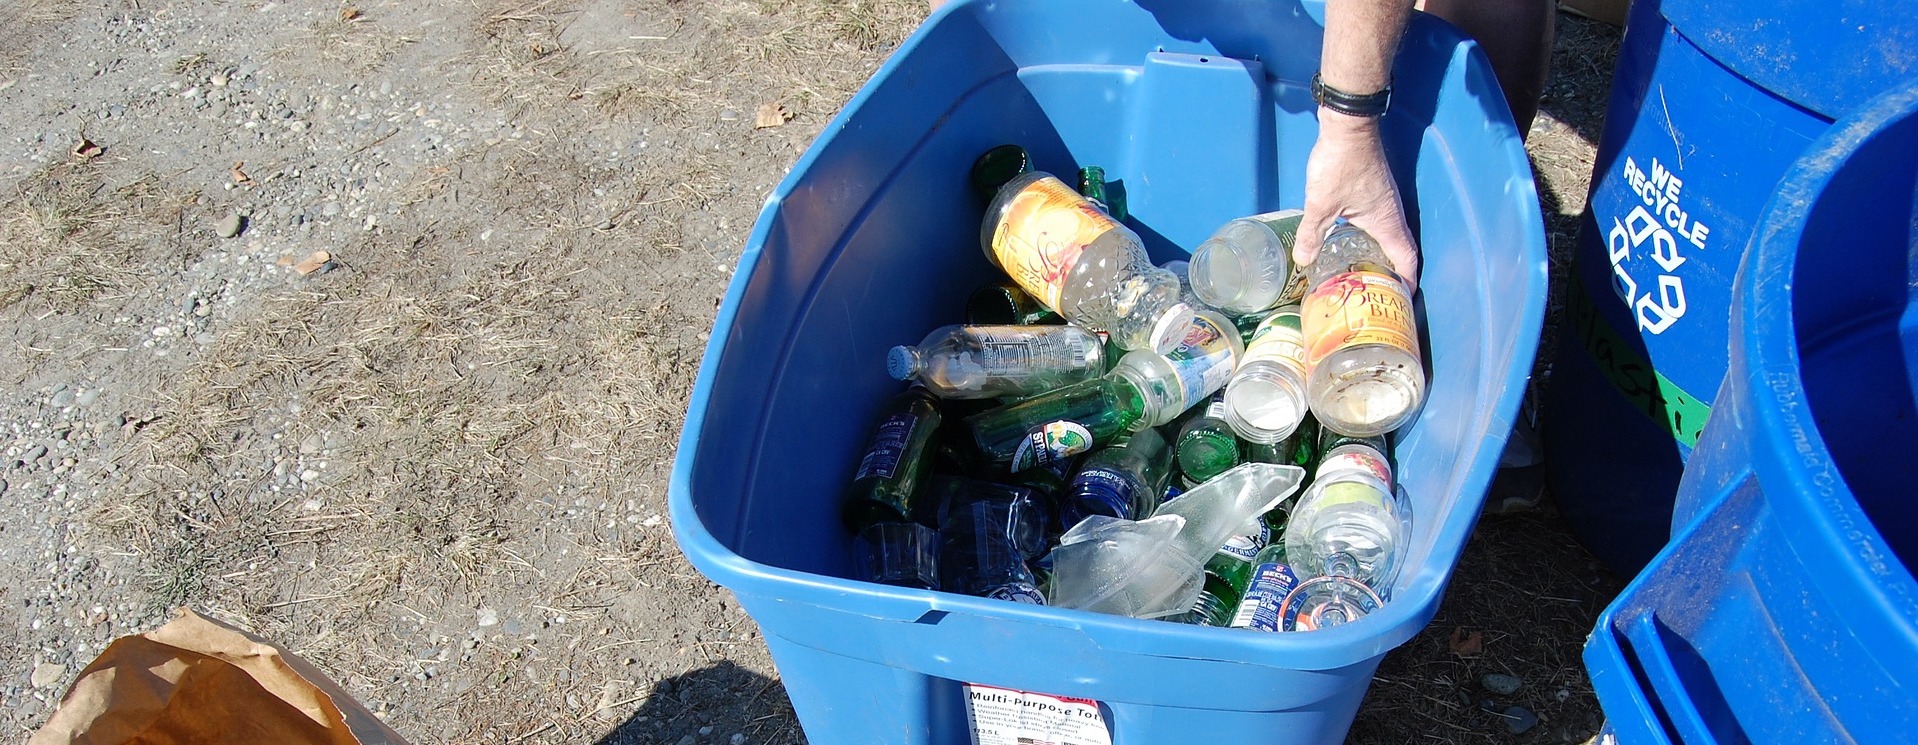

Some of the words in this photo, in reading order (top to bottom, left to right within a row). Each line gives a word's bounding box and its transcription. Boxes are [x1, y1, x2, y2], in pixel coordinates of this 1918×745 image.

[1624, 156, 1710, 250] RECYCLE
[1651, 157, 1683, 203] WE
[969, 691, 1072, 716] Multi-Purpose
